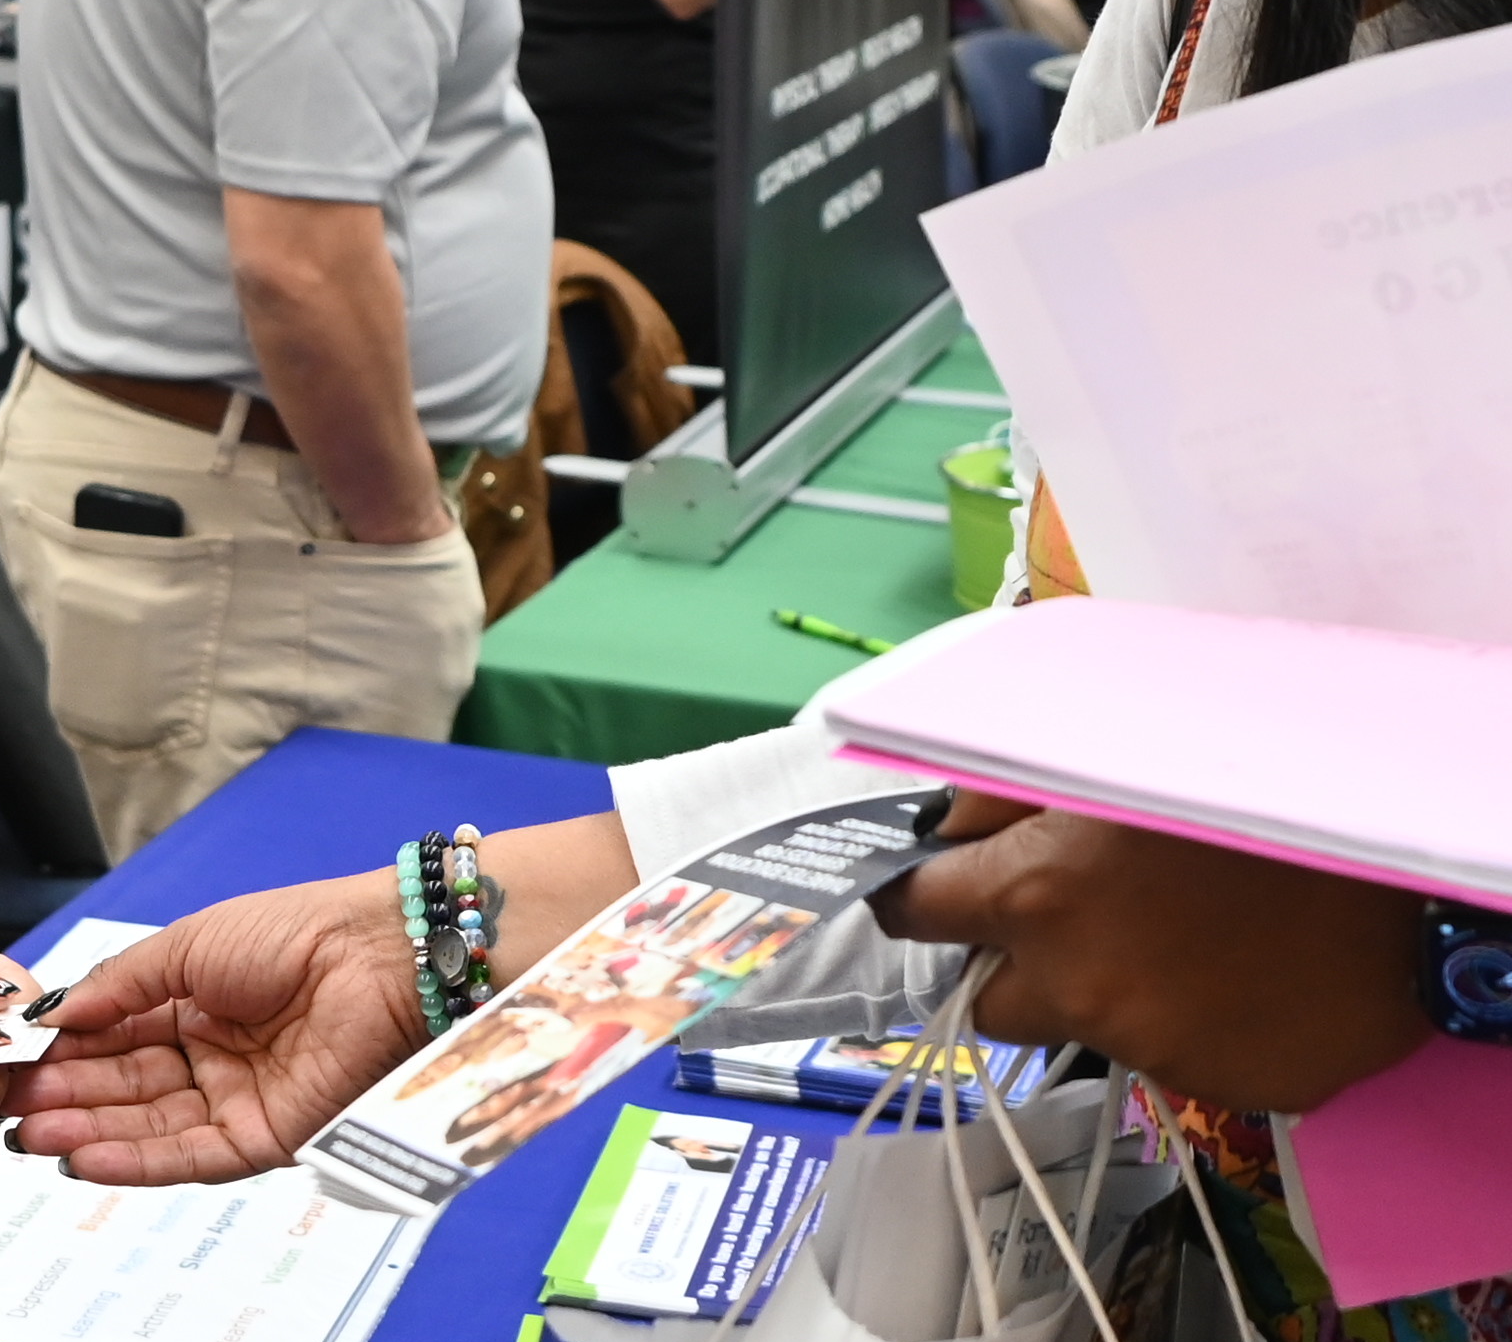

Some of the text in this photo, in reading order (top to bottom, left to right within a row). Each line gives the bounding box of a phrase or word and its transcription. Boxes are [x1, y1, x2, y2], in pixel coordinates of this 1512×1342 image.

[754, 1149, 772, 1163] on
[755, 1135, 778, 1152] the
[738, 1162, 771, 1194] hearing
[7, 1190, 53, 1231] Abuse
[76, 1190, 125, 1234] Bipolar
[730, 1192, 756, 1213] time
[179, 1196, 249, 1272] Sleep Apnea
[723, 1211, 747, 1235] hard
[114, 1243, 152, 1277] Math
[260, 1246, 305, 1287] Vision
[709, 1242, 736, 1265] have
[4, 1256, 74, 1321] Depression
[697, 1283, 720, 1299] Do
[706, 1264, 727, 1285] you
[62, 1288, 123, 1342] Learning
[132, 1290, 183, 1341] Arthritis
